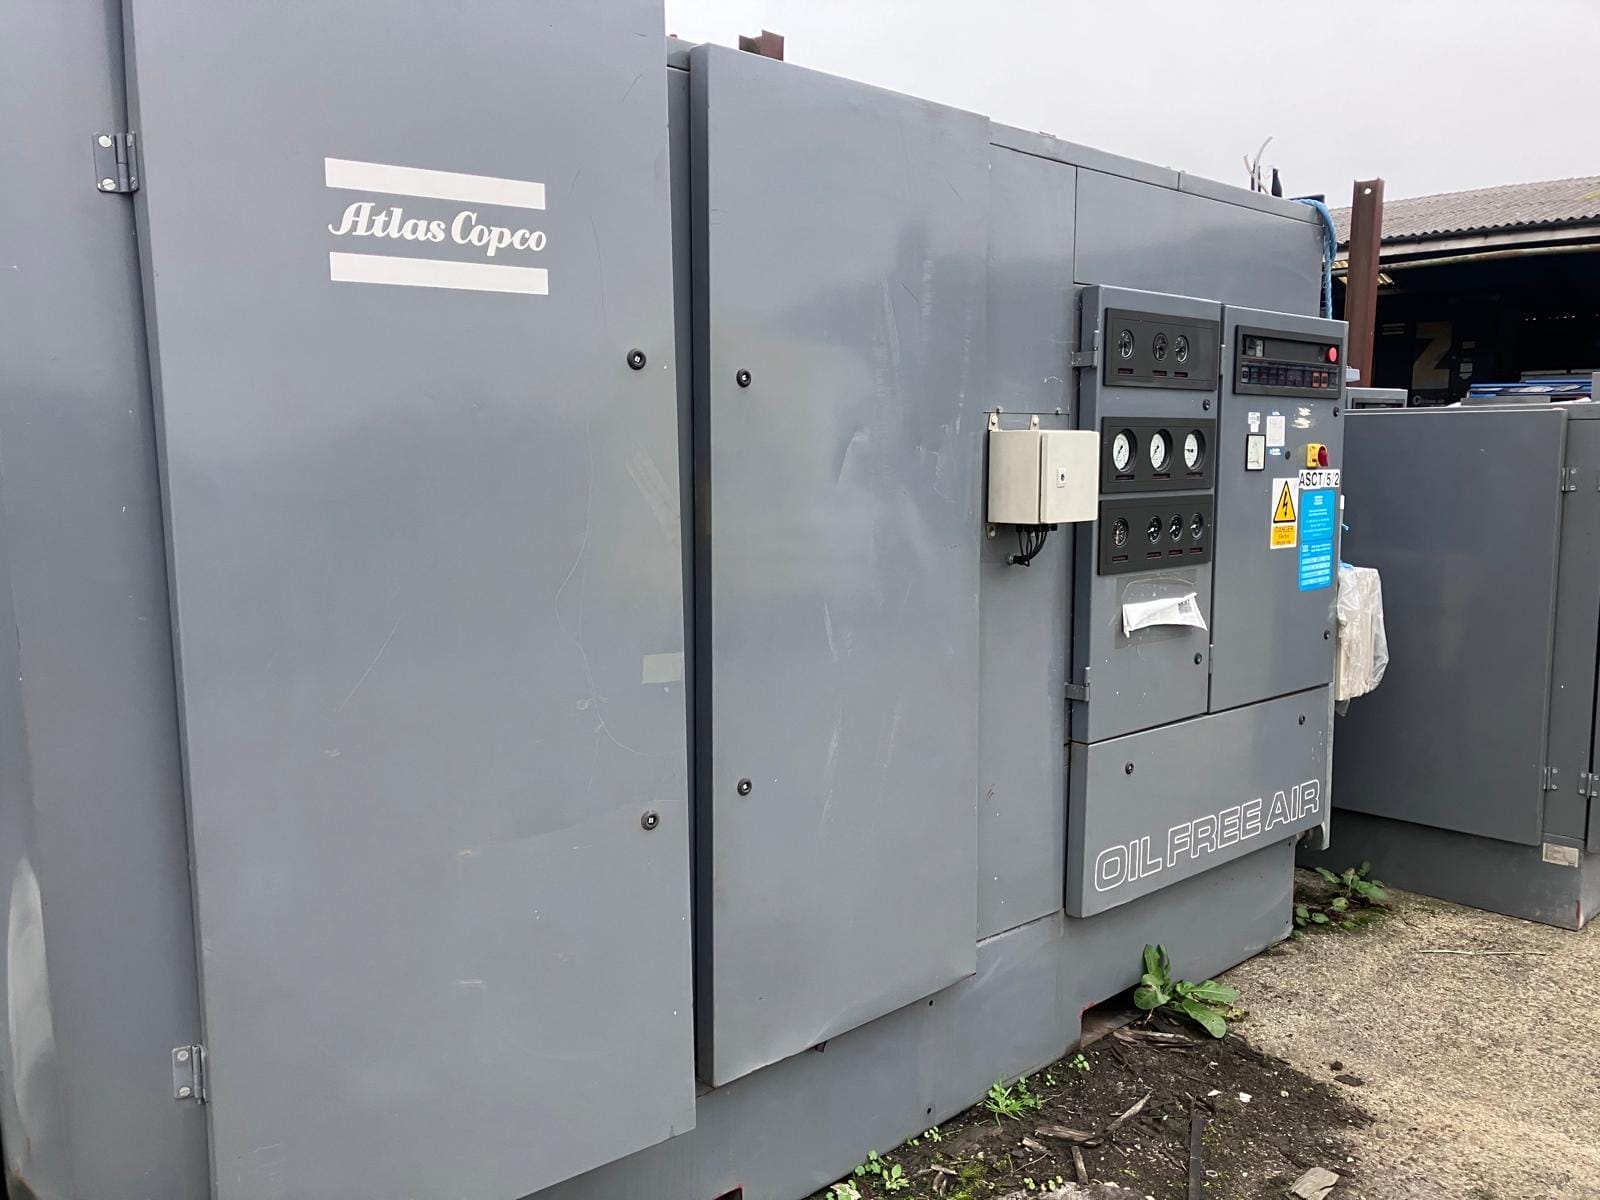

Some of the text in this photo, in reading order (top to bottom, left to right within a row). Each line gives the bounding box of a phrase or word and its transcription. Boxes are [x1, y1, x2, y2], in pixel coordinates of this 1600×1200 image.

[328, 202, 547, 257] Atlas Copco
[1094, 779, 1321, 892] OIL FREE AIR
